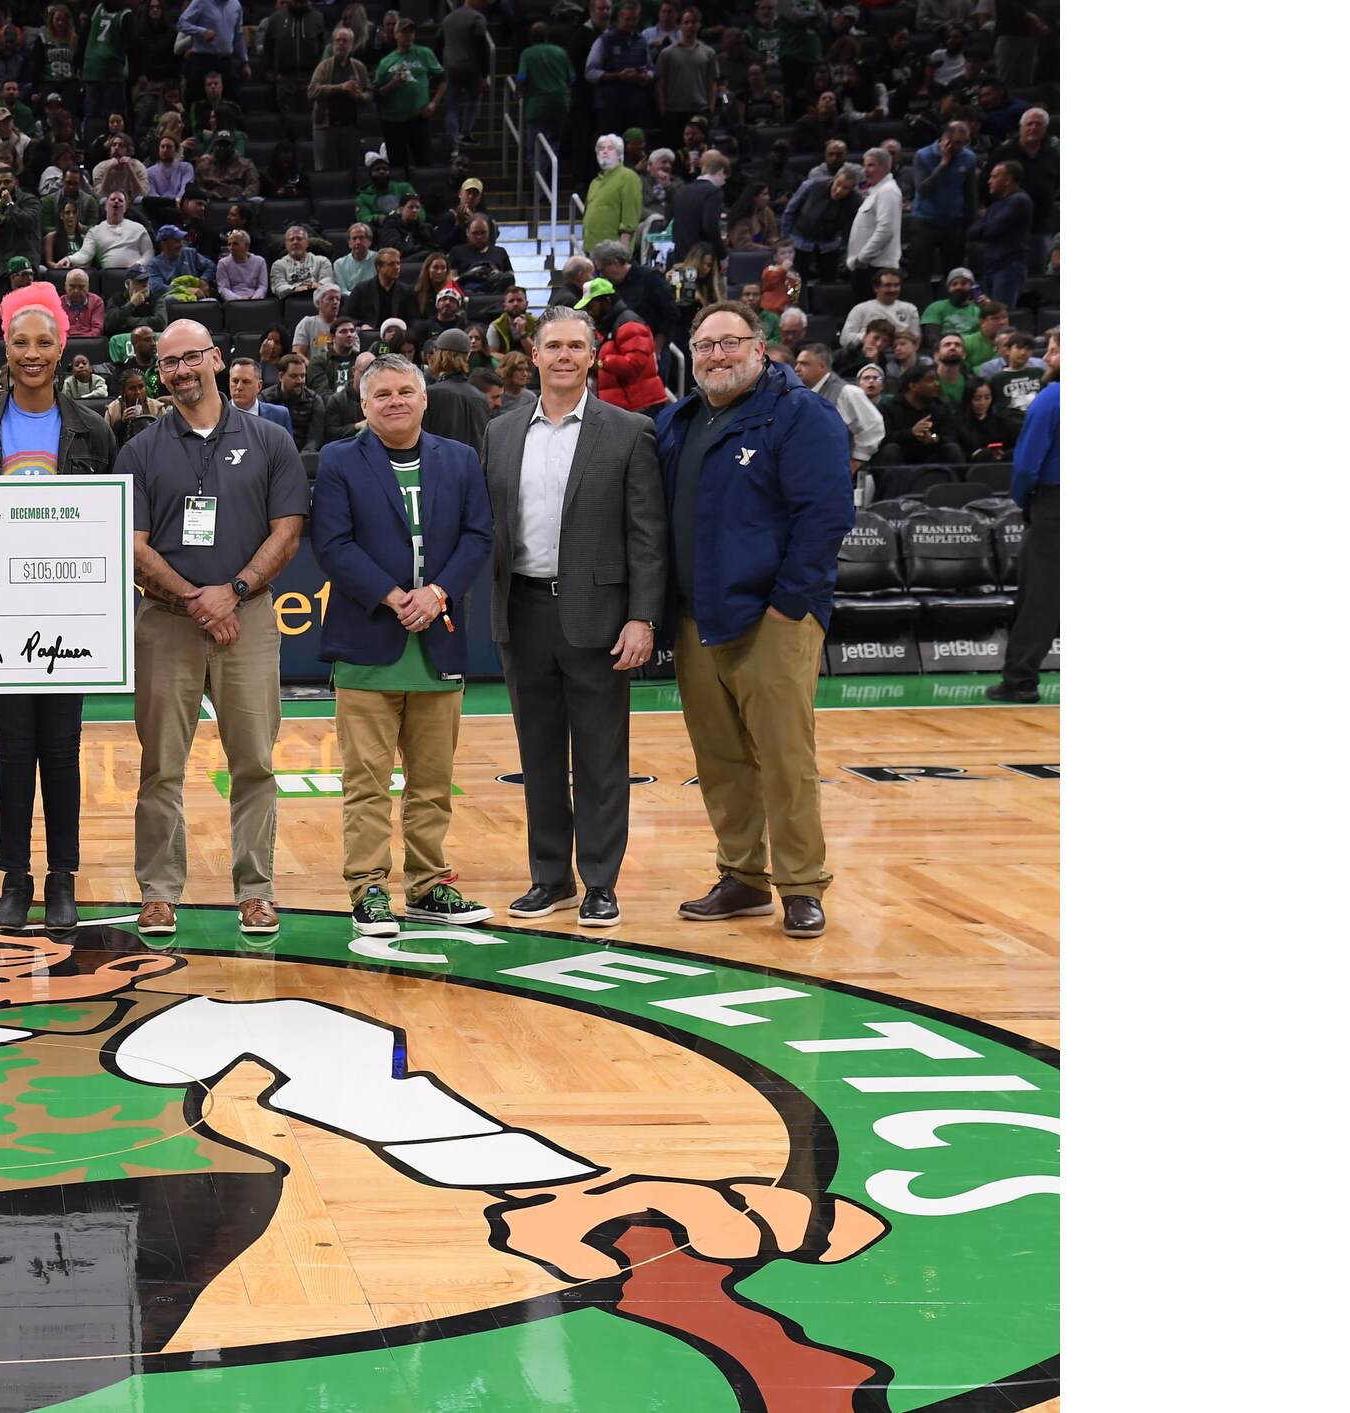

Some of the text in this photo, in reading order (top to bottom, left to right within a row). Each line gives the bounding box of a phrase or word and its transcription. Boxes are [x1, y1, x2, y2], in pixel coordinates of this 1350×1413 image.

[97, 19, 111, 41] 7
[10, 507, 50, 520] DECEMBER
[51, 507, 59, 521] 2,
[60, 507, 80, 520] 2024
[915, 525, 972, 533] FRANKLIN
[842, 643, 905, 662] jetBlue
[933, 640, 998, 660] jetBlue
[348, 931, 1060, 1216] CELTICS
